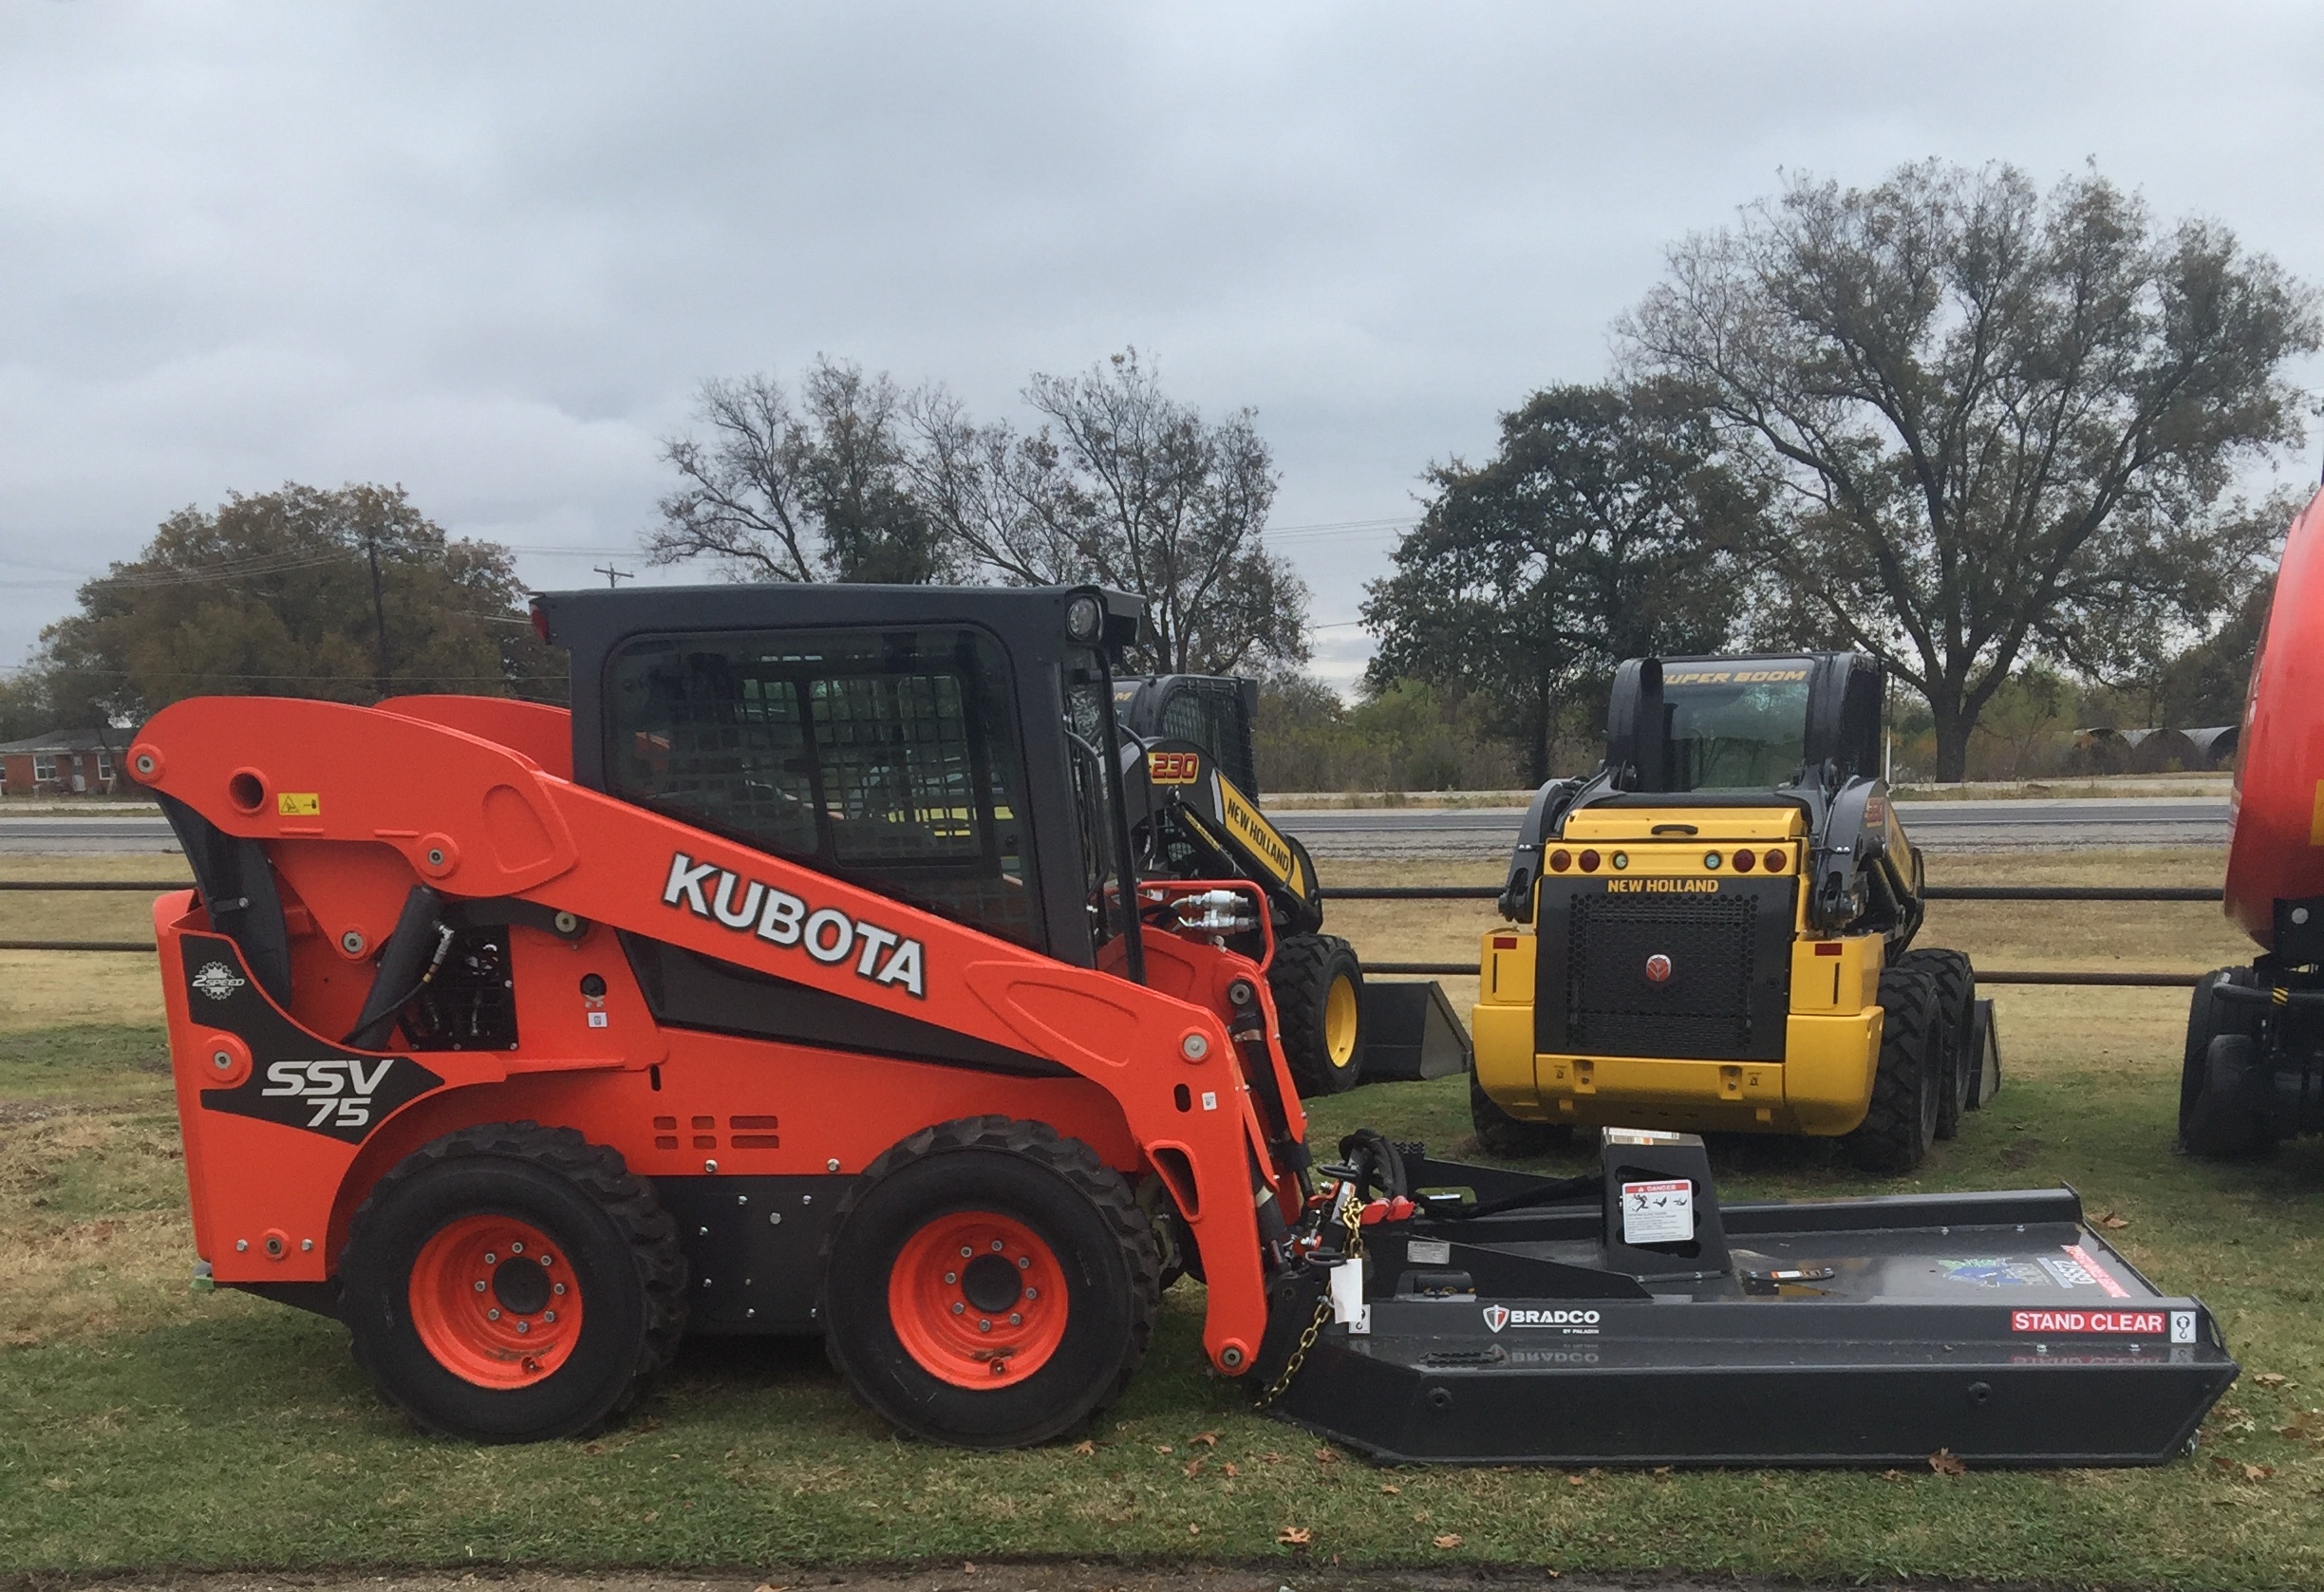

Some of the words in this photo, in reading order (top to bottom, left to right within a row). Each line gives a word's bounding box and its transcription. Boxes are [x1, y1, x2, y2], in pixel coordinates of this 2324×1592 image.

[1733, 670, 1807, 683] BOOM
[1227, 797, 1250, 832] NEW
[1249, 819, 1289, 872] HOLLAND
[1607, 879, 1643, 892] NEW
[1646, 879, 1719, 892] HOLLAND
[664, 852, 923, 997] KUBOTA
[261, 1059, 395, 1096] SSV
[306, 1097, 372, 1128] 75
[1647, 1184, 1677, 1192] DANGER
[1510, 1310, 1601, 1323] BRADCO
[2015, 1312, 2085, 1330] STAND
[2090, 1313, 2163, 1332] CLEAR
